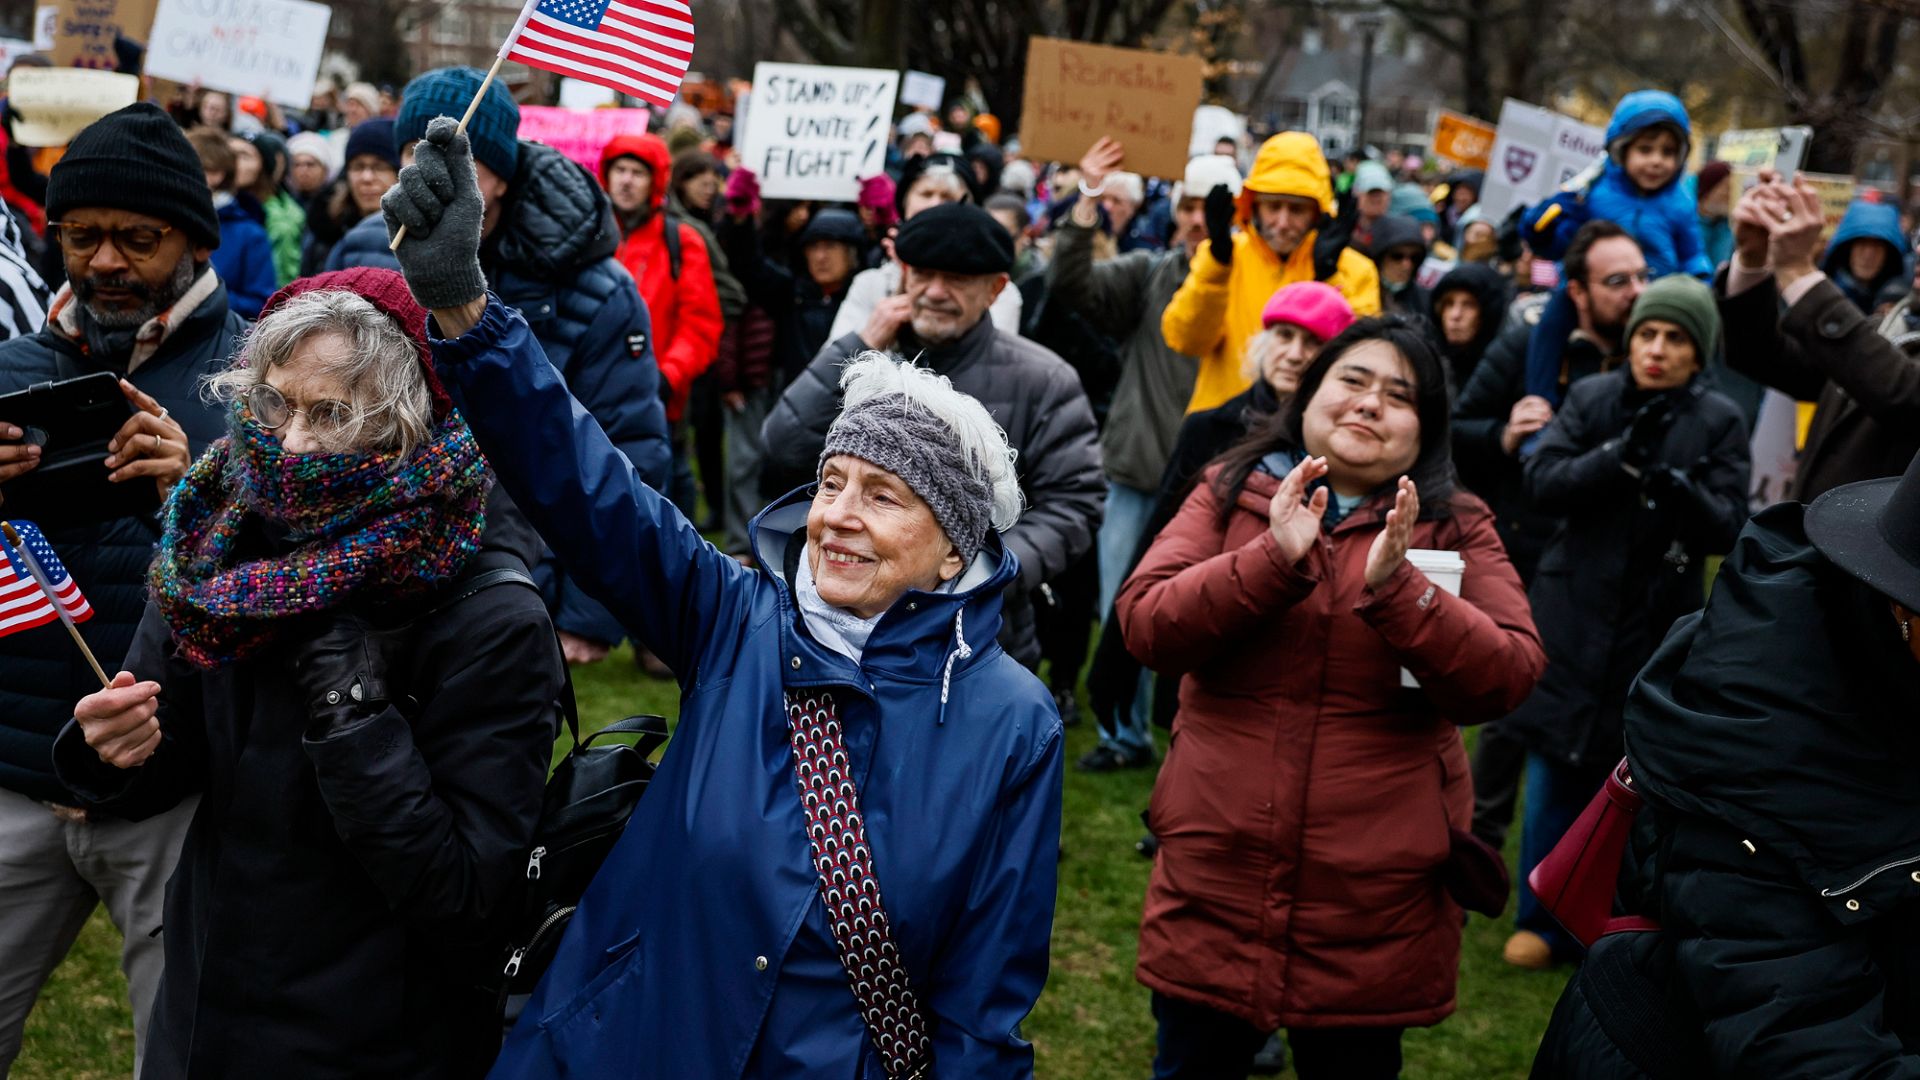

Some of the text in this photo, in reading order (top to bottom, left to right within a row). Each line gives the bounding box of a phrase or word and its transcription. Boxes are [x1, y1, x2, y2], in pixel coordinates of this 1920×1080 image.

[211, 24, 258, 45] NOT
[767, 75, 836, 104] STAND
[844, 80, 888, 109] UP!
[786, 114, 880, 142] UNITE!
[763, 138, 878, 181] FIGHT!
